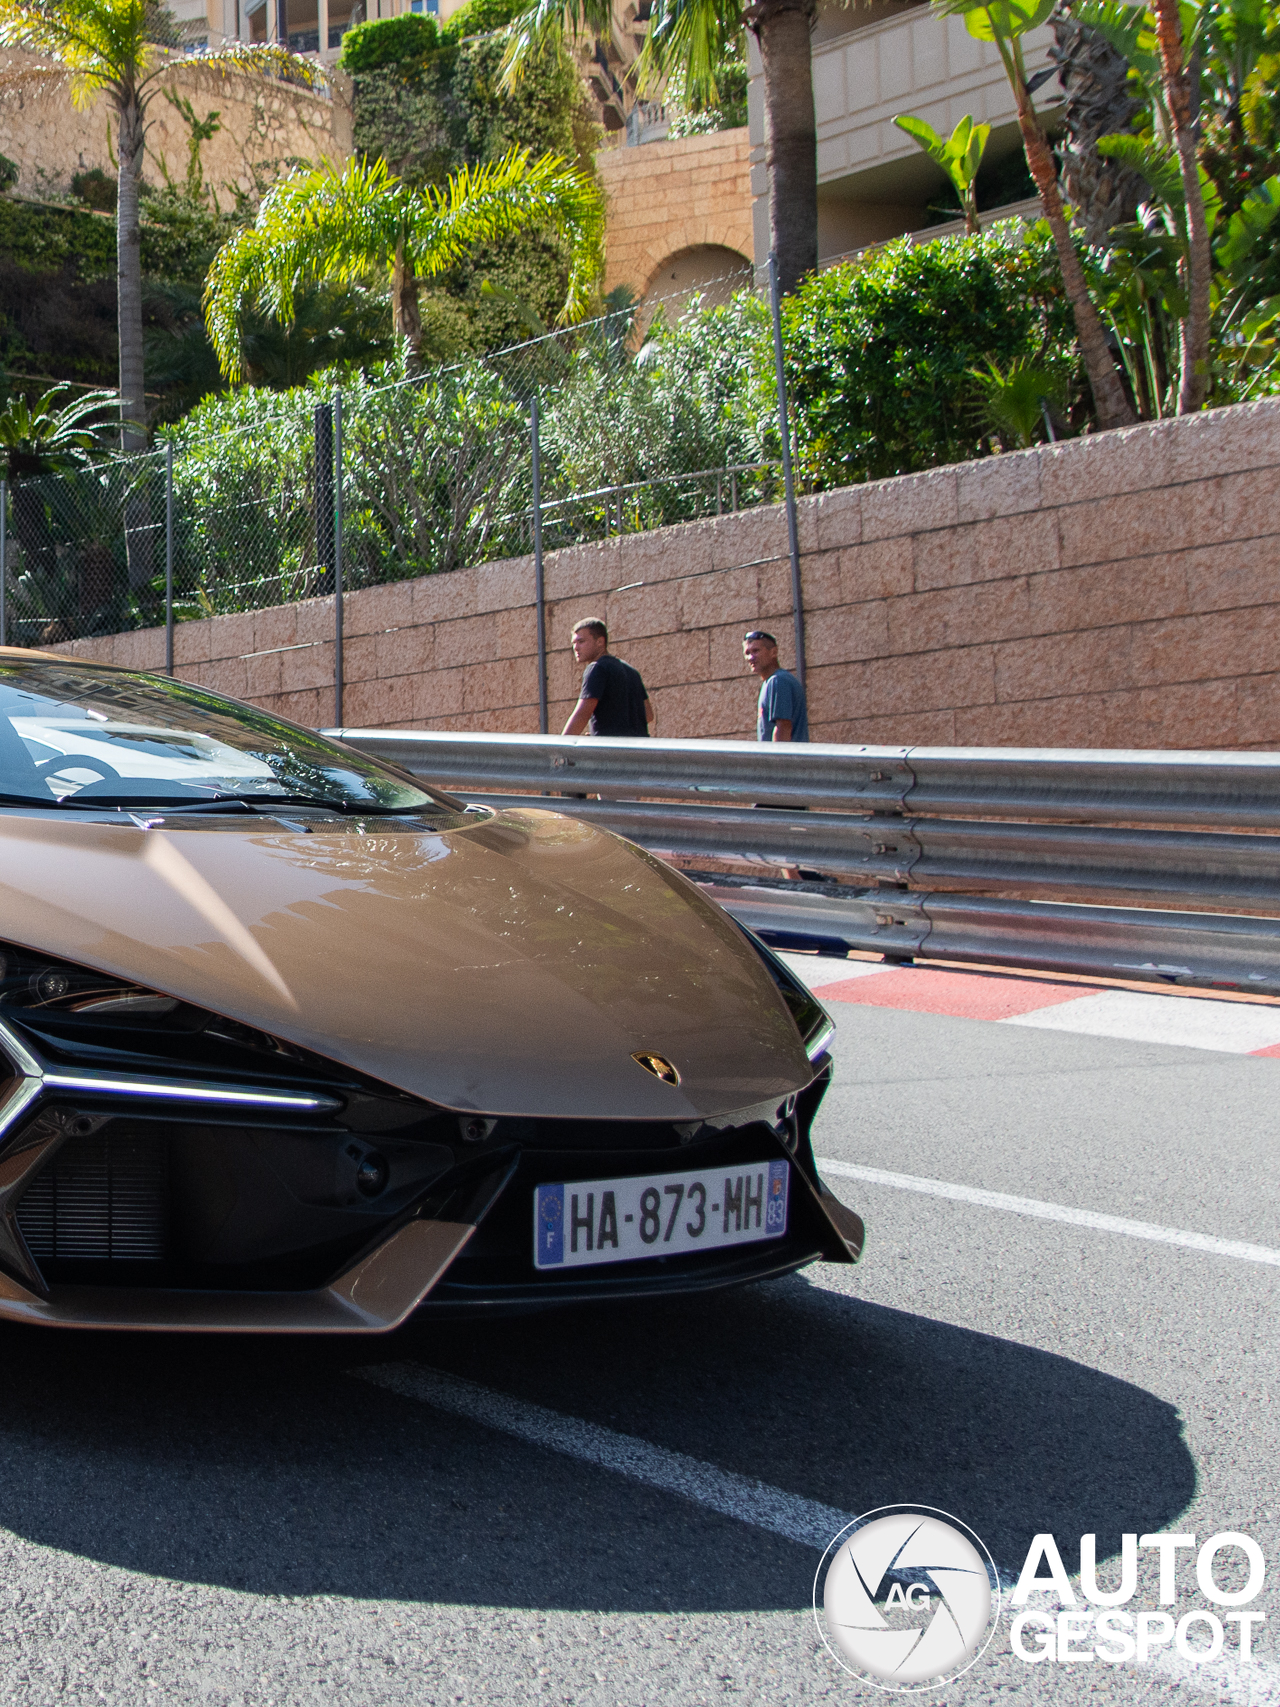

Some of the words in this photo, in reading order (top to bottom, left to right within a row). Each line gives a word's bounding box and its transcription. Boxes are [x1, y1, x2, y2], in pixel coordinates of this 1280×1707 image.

[570, 1173, 764, 1253] HA-873-MH
[767, 1200, 784, 1225] 83
[546, 1231, 555, 1249] F
